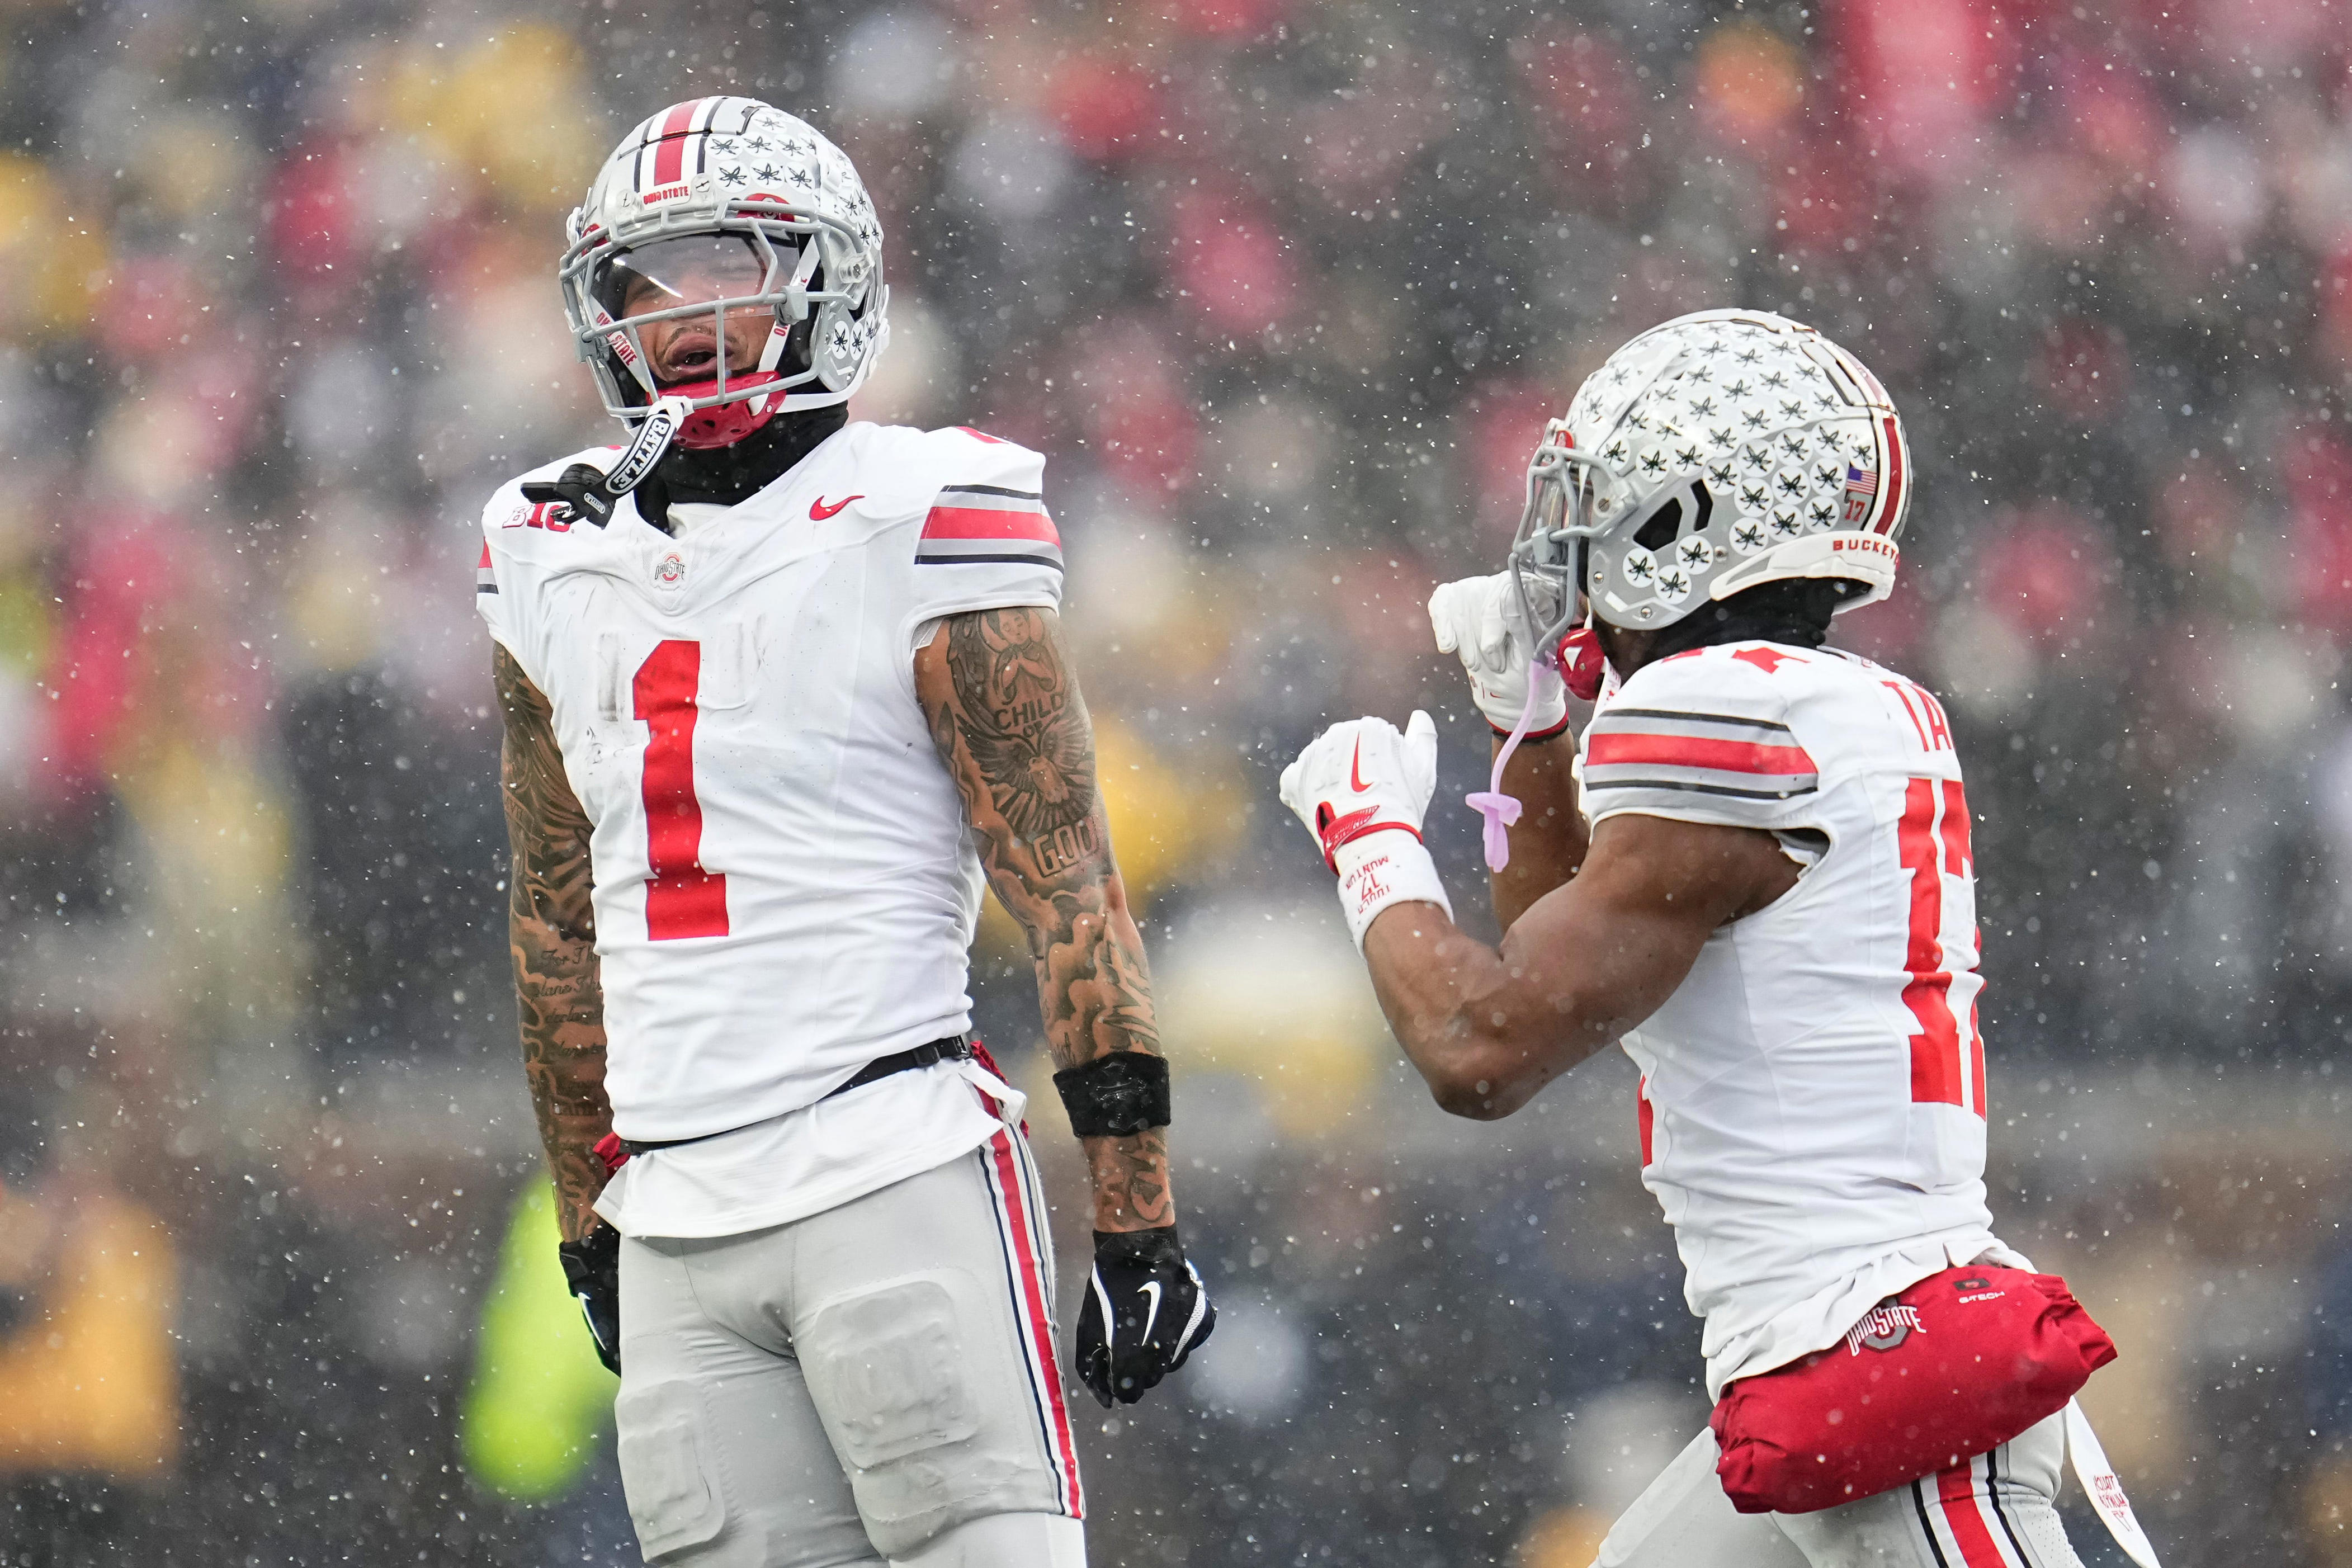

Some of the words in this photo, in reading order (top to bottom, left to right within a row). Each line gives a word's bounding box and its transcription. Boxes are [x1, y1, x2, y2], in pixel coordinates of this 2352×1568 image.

[644, 191, 661, 205] OHIO
[662, 186, 689, 199] STATE
[613, 335, 637, 366] STATE
[613, 419, 670, 489] BATTLE
[1845, 499, 1865, 521] 17
[1833, 539, 1900, 564] BUCKEY
[994, 693, 1065, 730] CHILD
[1879, 681, 1956, 752] TA
[632, 640, 729, 941] 1
[1361, 873, 1380, 901] 17
[1872, 1306, 1927, 1335] STATE
